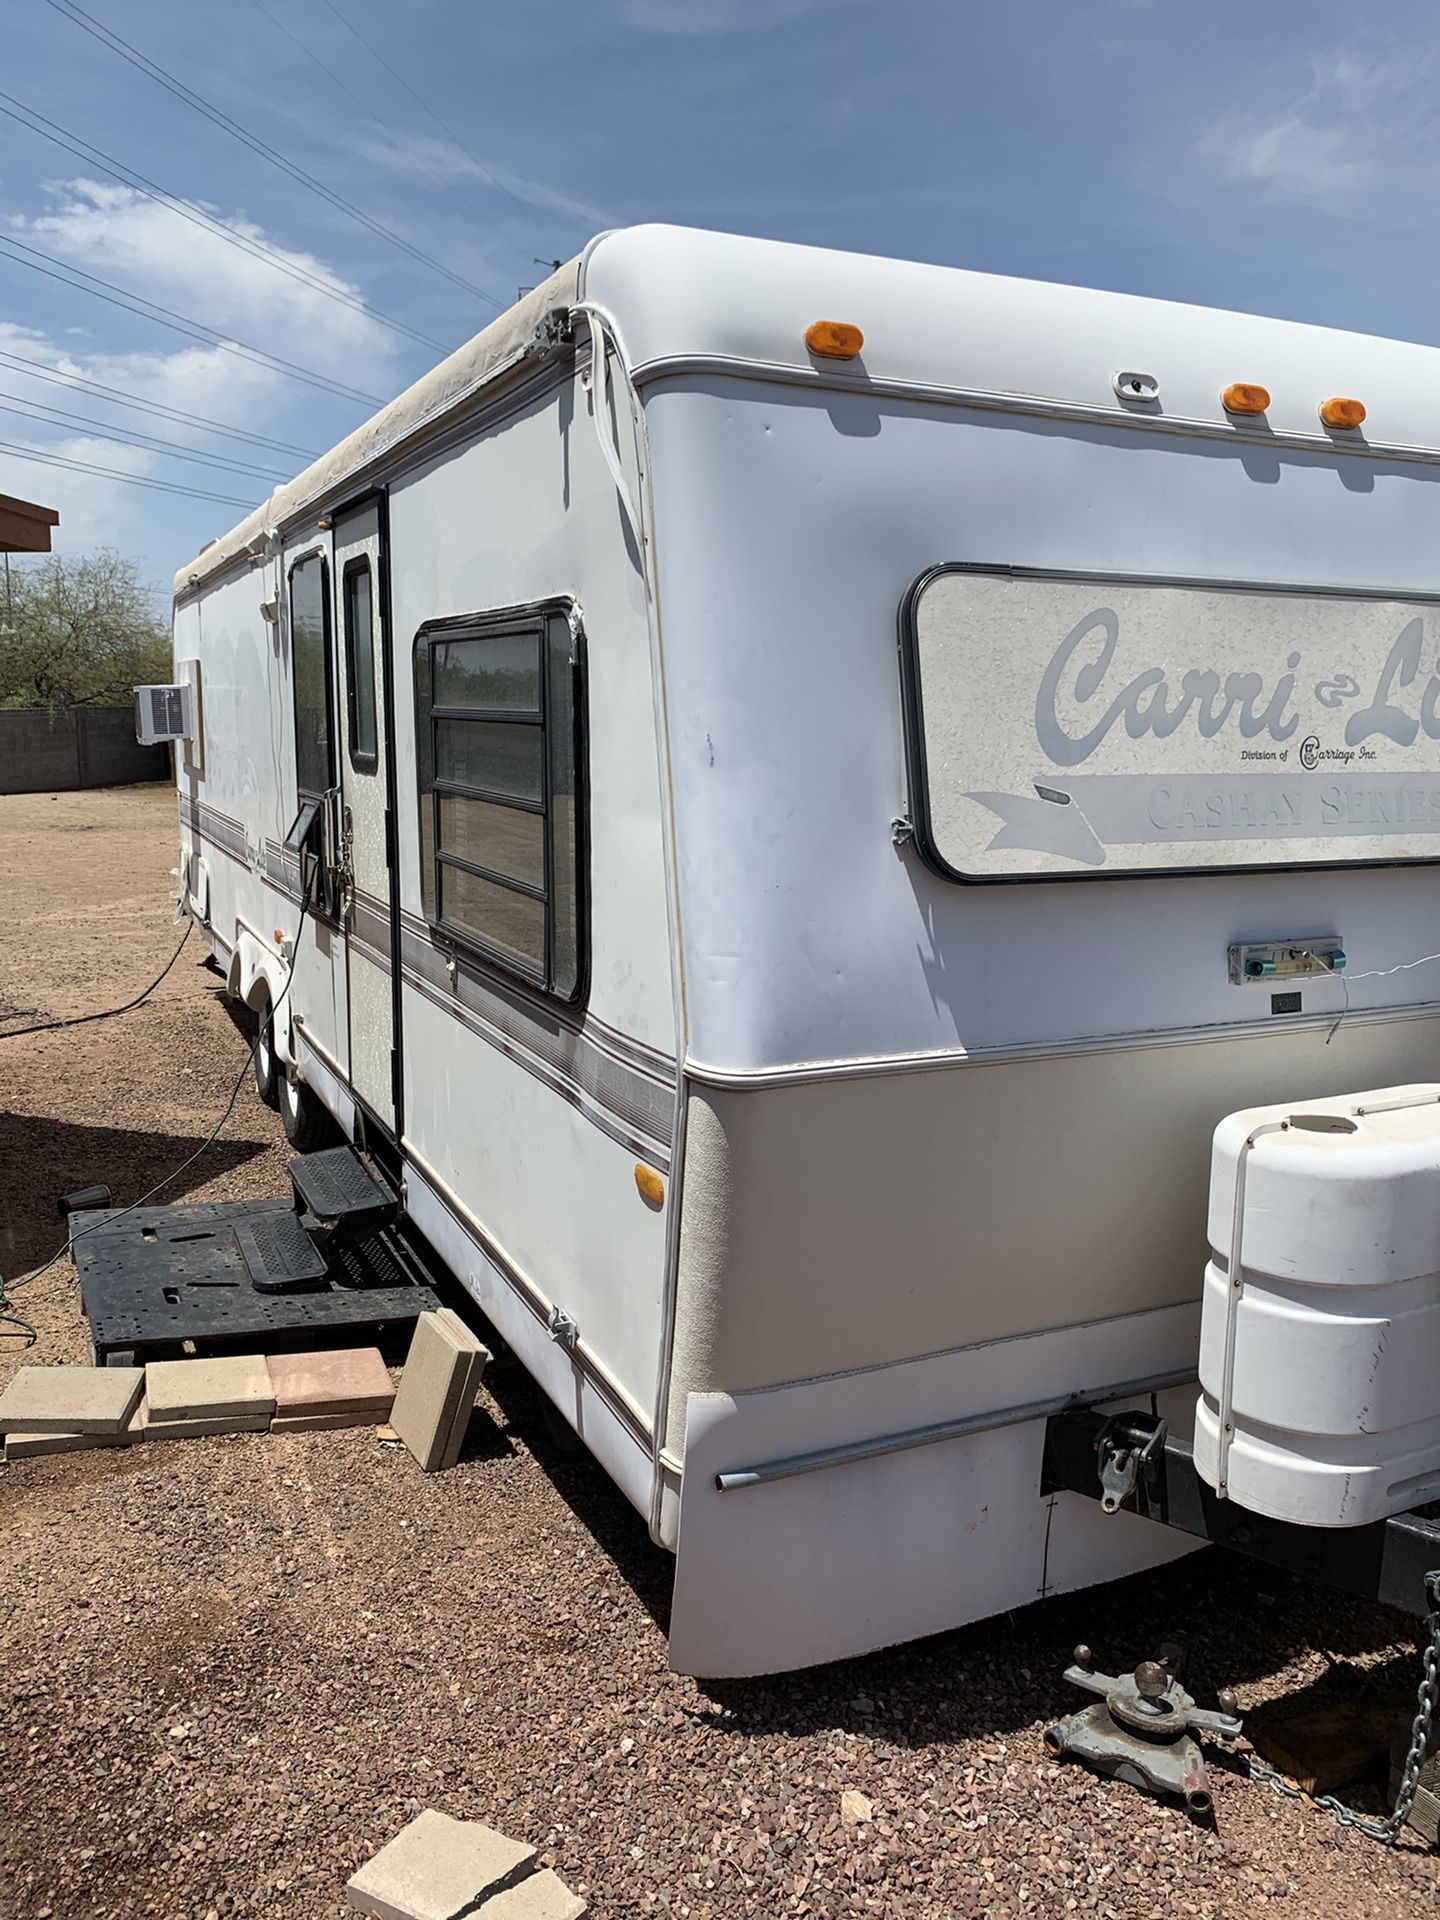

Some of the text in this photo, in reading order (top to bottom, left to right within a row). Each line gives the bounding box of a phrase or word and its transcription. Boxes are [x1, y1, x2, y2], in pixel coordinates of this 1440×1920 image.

[1241, 735, 1377, 770] Division of Carriage Inc.
